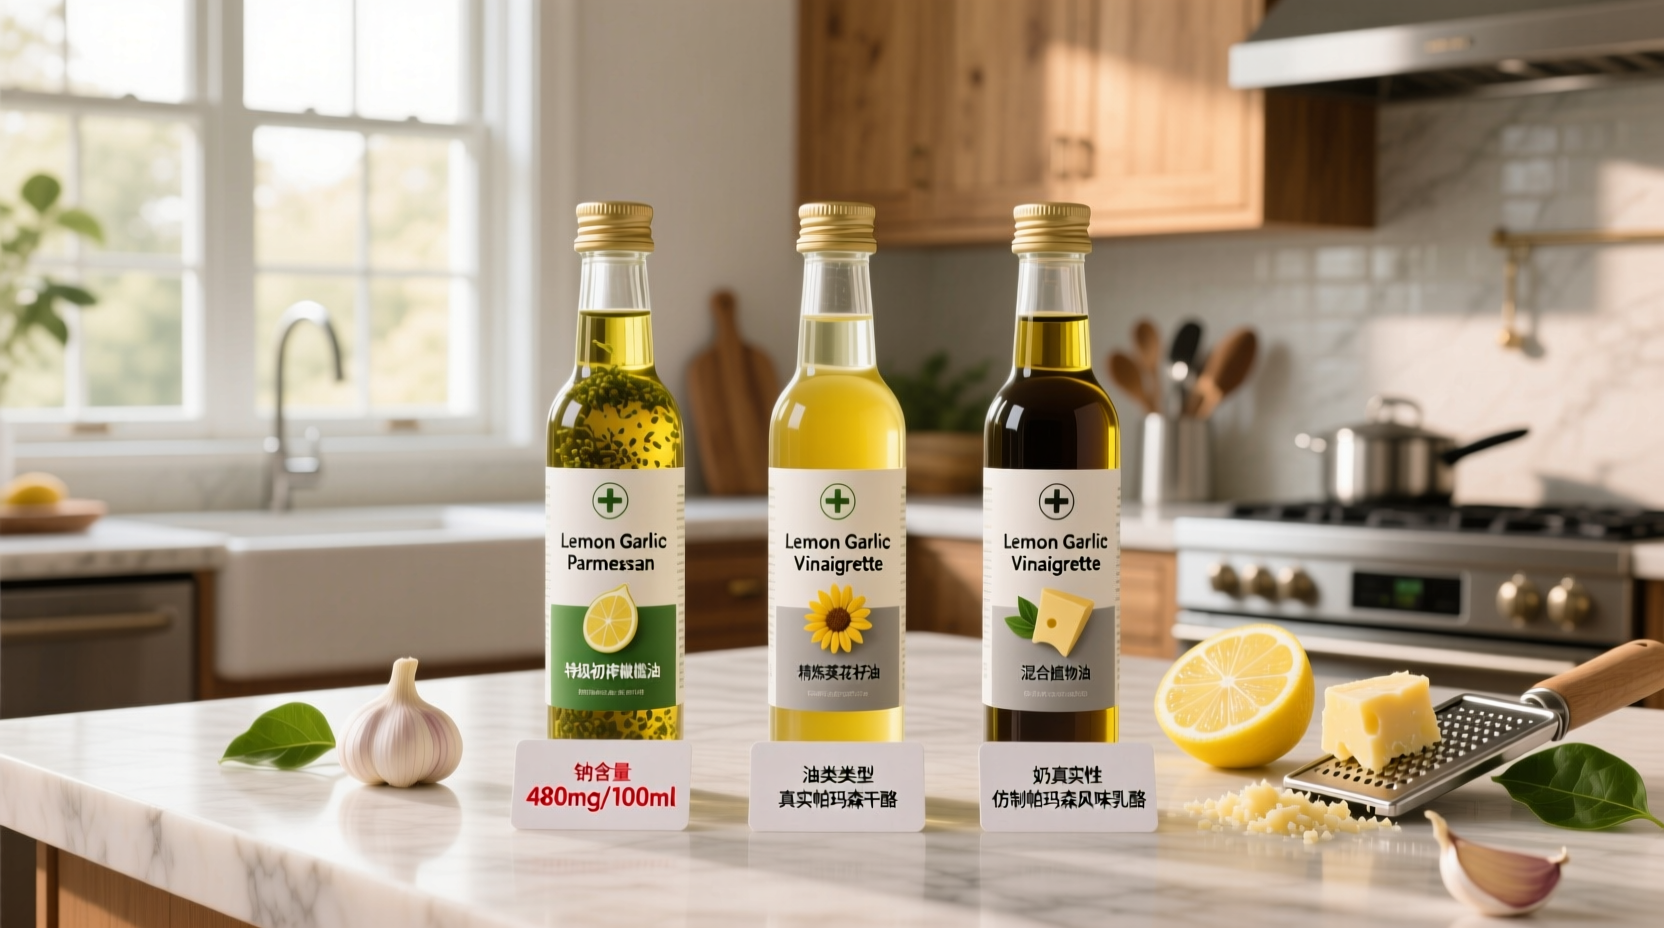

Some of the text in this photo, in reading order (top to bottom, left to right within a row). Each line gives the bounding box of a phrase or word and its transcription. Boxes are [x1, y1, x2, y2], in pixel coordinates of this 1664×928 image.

[561, 531, 667, 550] Lemon Garlic
[785, 532, 891, 550] Lemon Garlic
[1004, 532, 1108, 550] Lemon Garlic
[794, 555, 884, 577] Vinaigrette
[1011, 555, 1101, 577] Vinaigrette
[574, 762, 630, 782] 钠含量
[802, 765, 874, 784] 油类类型
[1032, 765, 1103, 785] 奶真实性
[525, 785, 676, 813] 480mg/100ml
[778, 788, 898, 810] 真实帕玛森干酪
[991, 789, 1147, 810] 仿制帕玛森风味乳酪
